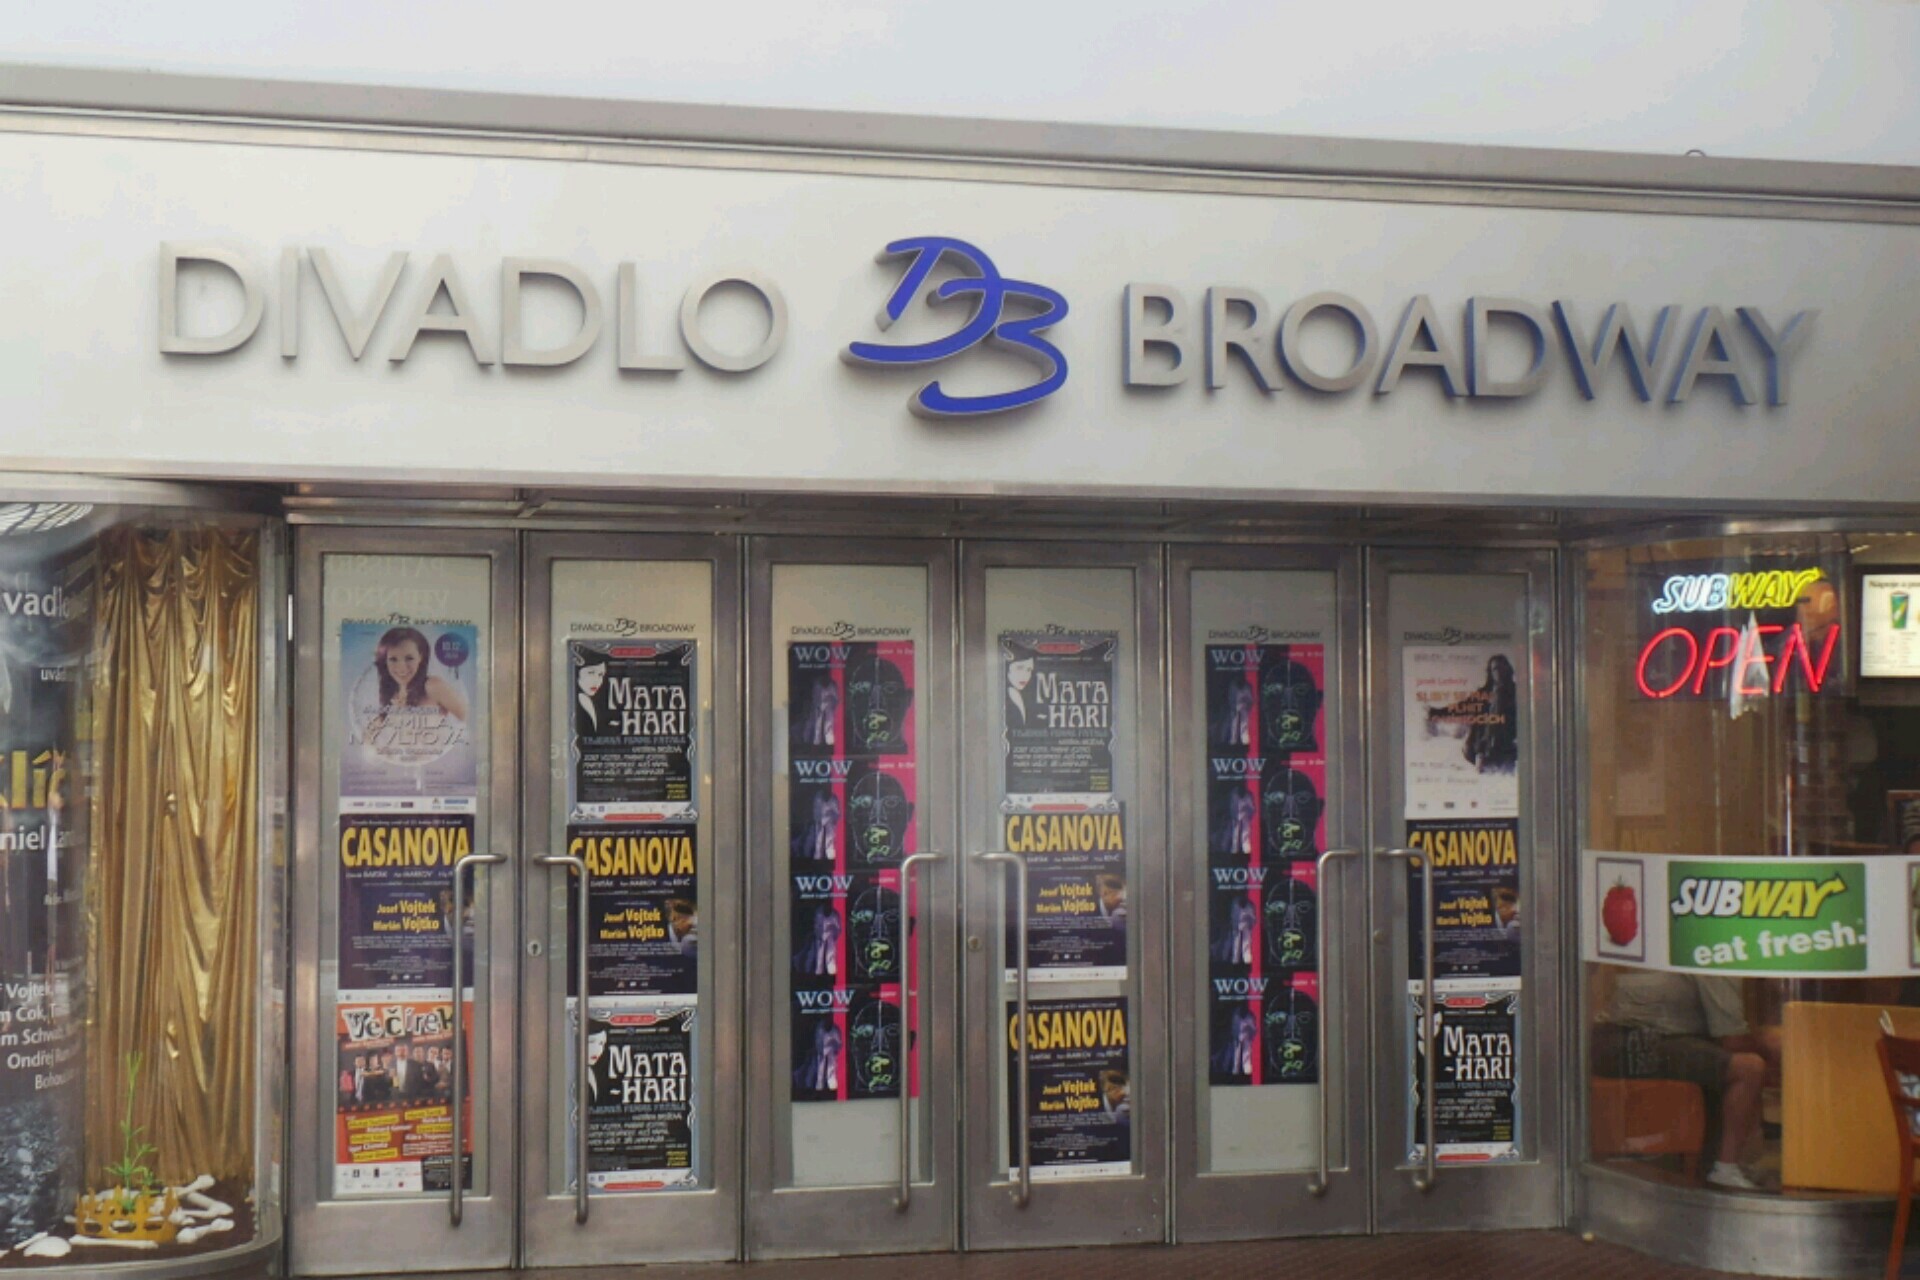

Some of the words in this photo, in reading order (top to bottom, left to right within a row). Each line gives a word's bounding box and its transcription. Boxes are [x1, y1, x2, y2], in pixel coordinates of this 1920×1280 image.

[159, 242, 789, 372] DIVADLO
[1122, 282, 1821, 407] BROADWAY
[1652, 567, 1824, 614] SUBWAY
[570, 623, 615, 633] DIVADLO
[639, 623, 696, 633] BROADWAY
[791, 626, 833, 635] DIVADLO
[856, 627, 911, 636] BROADWAY
[794, 646, 852, 662] WOW
[1211, 649, 1265, 664] WOW
[1635, 623, 1840, 698] OPEN
[608, 677, 687, 710] MATA
[1036, 672, 1109, 704] MATA
[794, 760, 853, 776] WOW
[1212, 758, 1267, 774] WOW
[341, 827, 470, 867] CASANOVA
[1007, 814, 1123, 852] CASANOVA
[1408, 829, 1517, 867] CASANOVA
[569, 837, 694, 876] CASANOVA
[795, 875, 854, 892] WOW
[1213, 867, 1268, 883] WOW
[1670, 872, 1847, 918] SUBWAY
[1693, 936, 1749, 966] eat
[1756, 920, 1867, 959] fresh.
[795, 990, 855, 1007] WOW
[1213, 978, 1269, 994] WOW
[1009, 1009, 1126, 1050] CASANOVA
[1443, 1025, 1512, 1056] MATA
[608, 1045, 687, 1078] MATA
